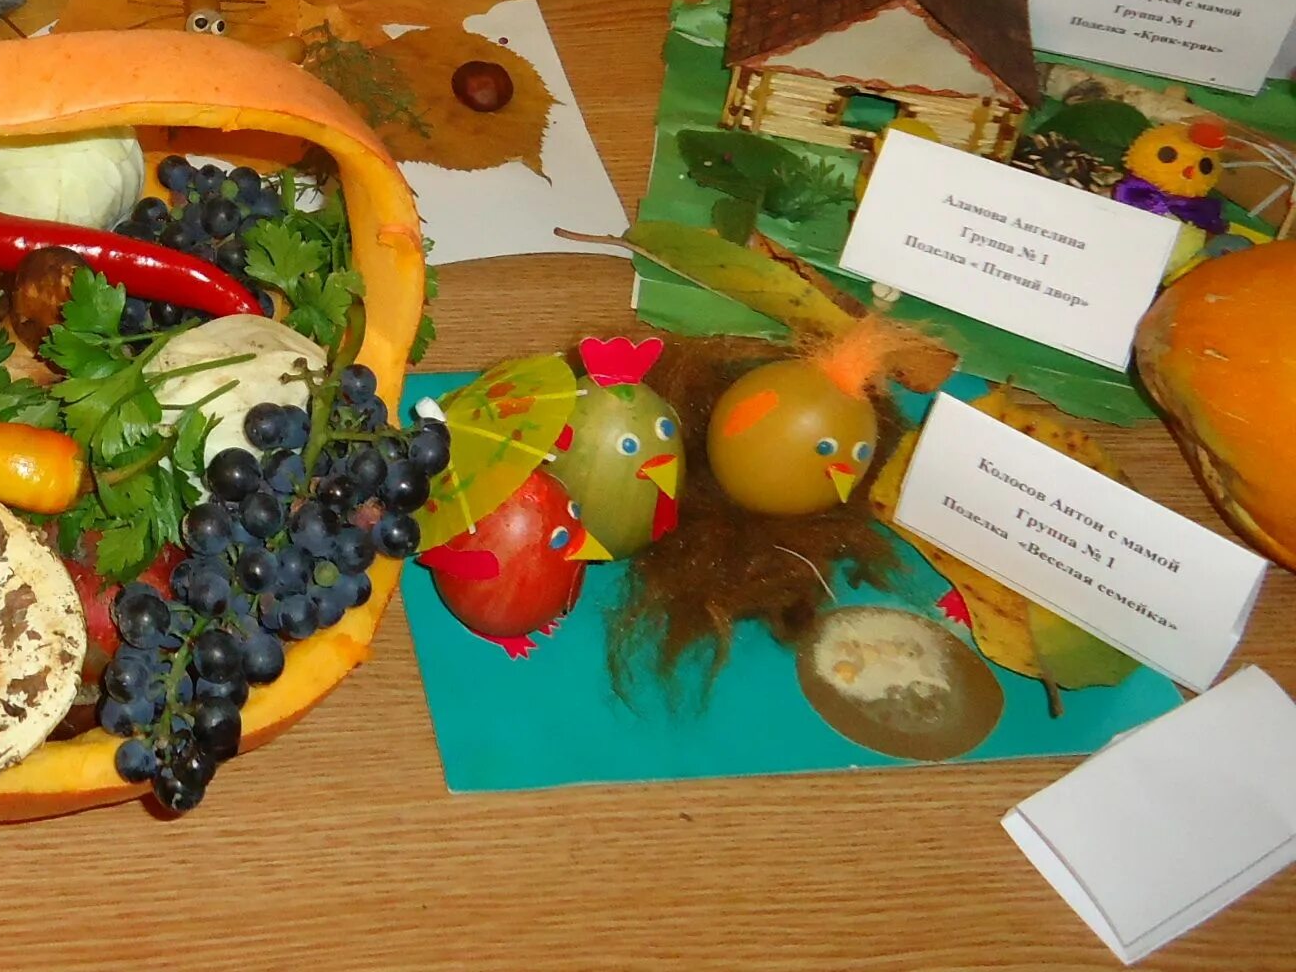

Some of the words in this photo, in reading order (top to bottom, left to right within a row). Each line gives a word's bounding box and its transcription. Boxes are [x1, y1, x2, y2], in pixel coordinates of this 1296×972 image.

[1070, 15, 1127, 35] Поделка
[1113, 4, 1164, 22] Группа
[1165, 14, 1183, 27] №
[1186, 19, 1195, 29] 1
[1185, 0, 1193, 8] с
[1195, 1, 1242, 18] мамой
[959, 226, 1015, 255] Группа
[1017, 246, 1037, 262] №
[1039, 253, 1049, 266] 1
[1011, 216, 1087, 251] Ангелина
[903, 233, 967, 265] Поделка
[1043, 286, 1089, 308] двор»
[977, 457, 1047, 503] Колосов
[1049, 497, 1104, 534] Антон
[1107, 528, 1118, 540] с
[1121, 536, 1181, 574] мамой
[1015, 507, 1078, 550] Группа
[1081, 543, 1102, 563] №
[1105, 556, 1117, 570] 1
[941, 494, 1009, 541] Поделка
[1017, 539, 1093, 587] «Веселая
[1096, 582, 1179, 631] семейка»
